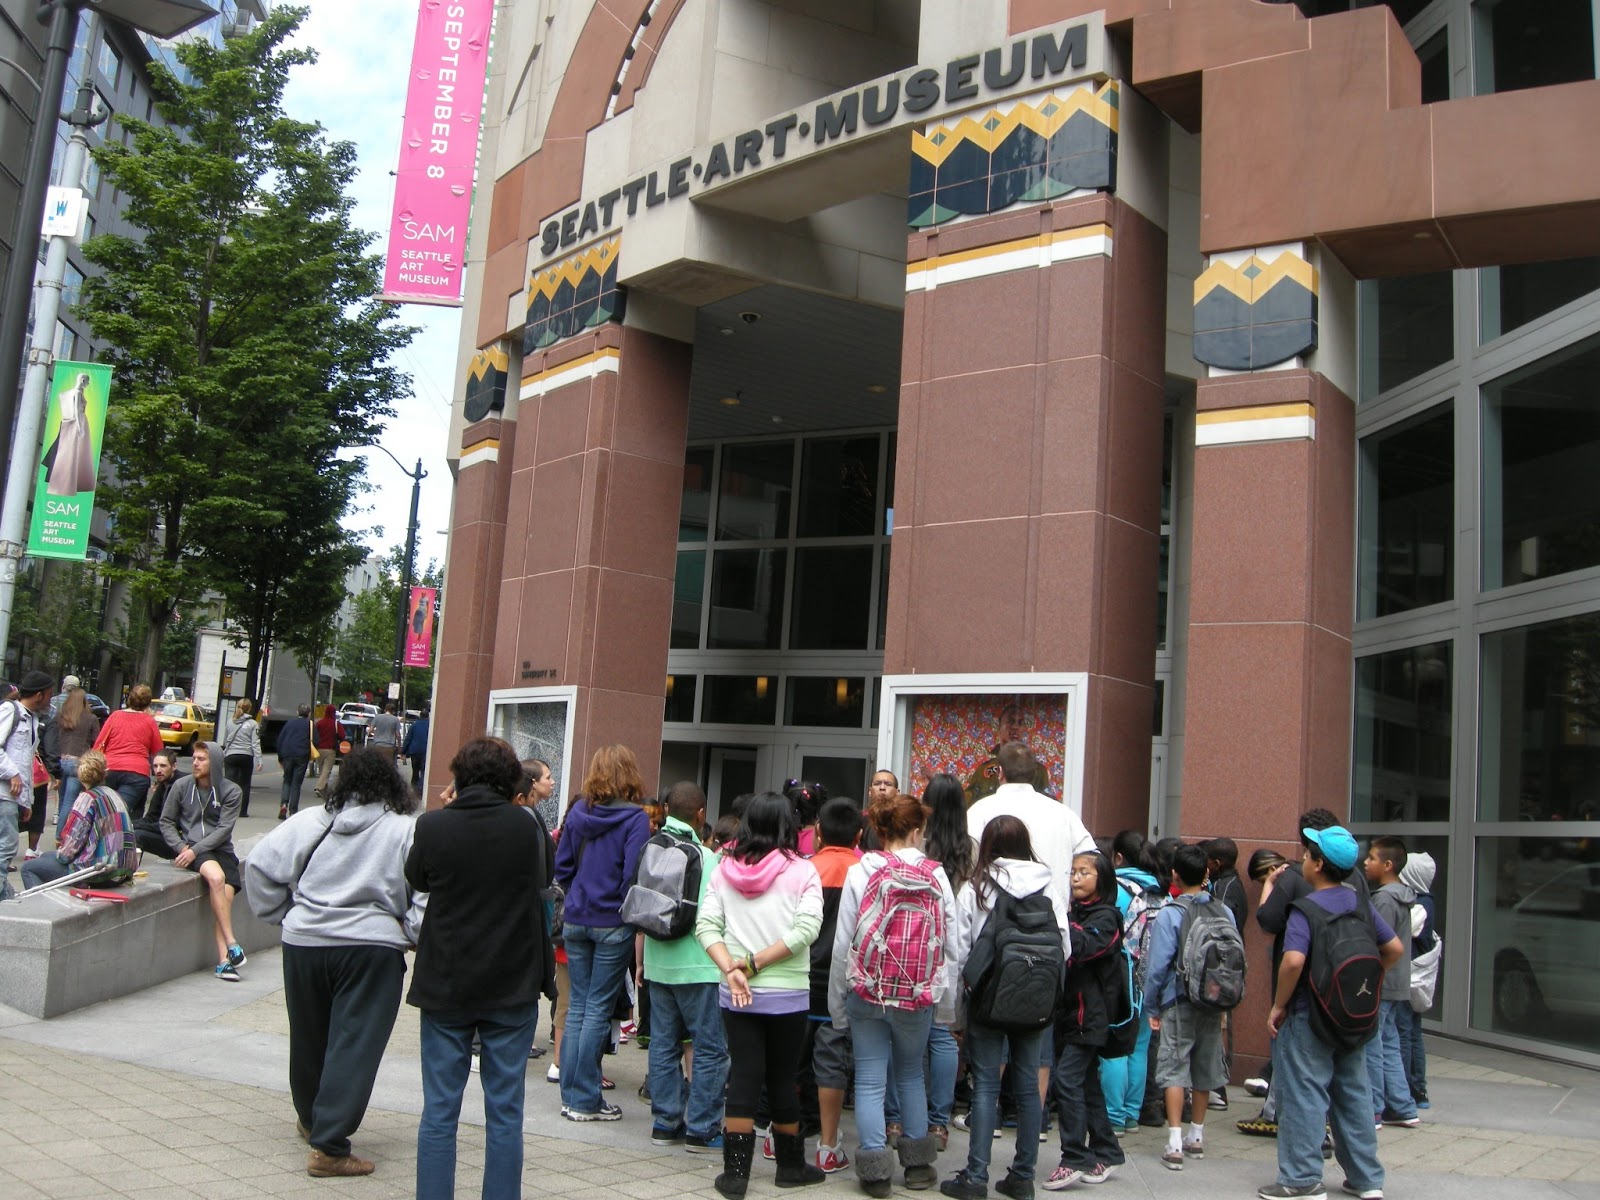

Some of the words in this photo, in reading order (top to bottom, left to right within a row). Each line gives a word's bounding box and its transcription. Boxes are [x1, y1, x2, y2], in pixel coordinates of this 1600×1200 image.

[540, 156, 692, 256] SEATTLE
[702, 114, 797, 184] ART
[814, 24, 1088, 144] MUSEUM
[427, 164, 445, 179] 8
[403, 221, 454, 243] SAM
[401, 249, 451, 262] SEATTLE
[400, 261, 424, 271] ART
[399, 272, 449, 286] MUSEUM
[46, 501, 80, 516] SAM
[44, 520, 77, 530] SEATTLE
[43, 528, 59, 536] ART
[42, 536, 75, 545] MUSEUM
[411, 642, 426, 650] SAM
